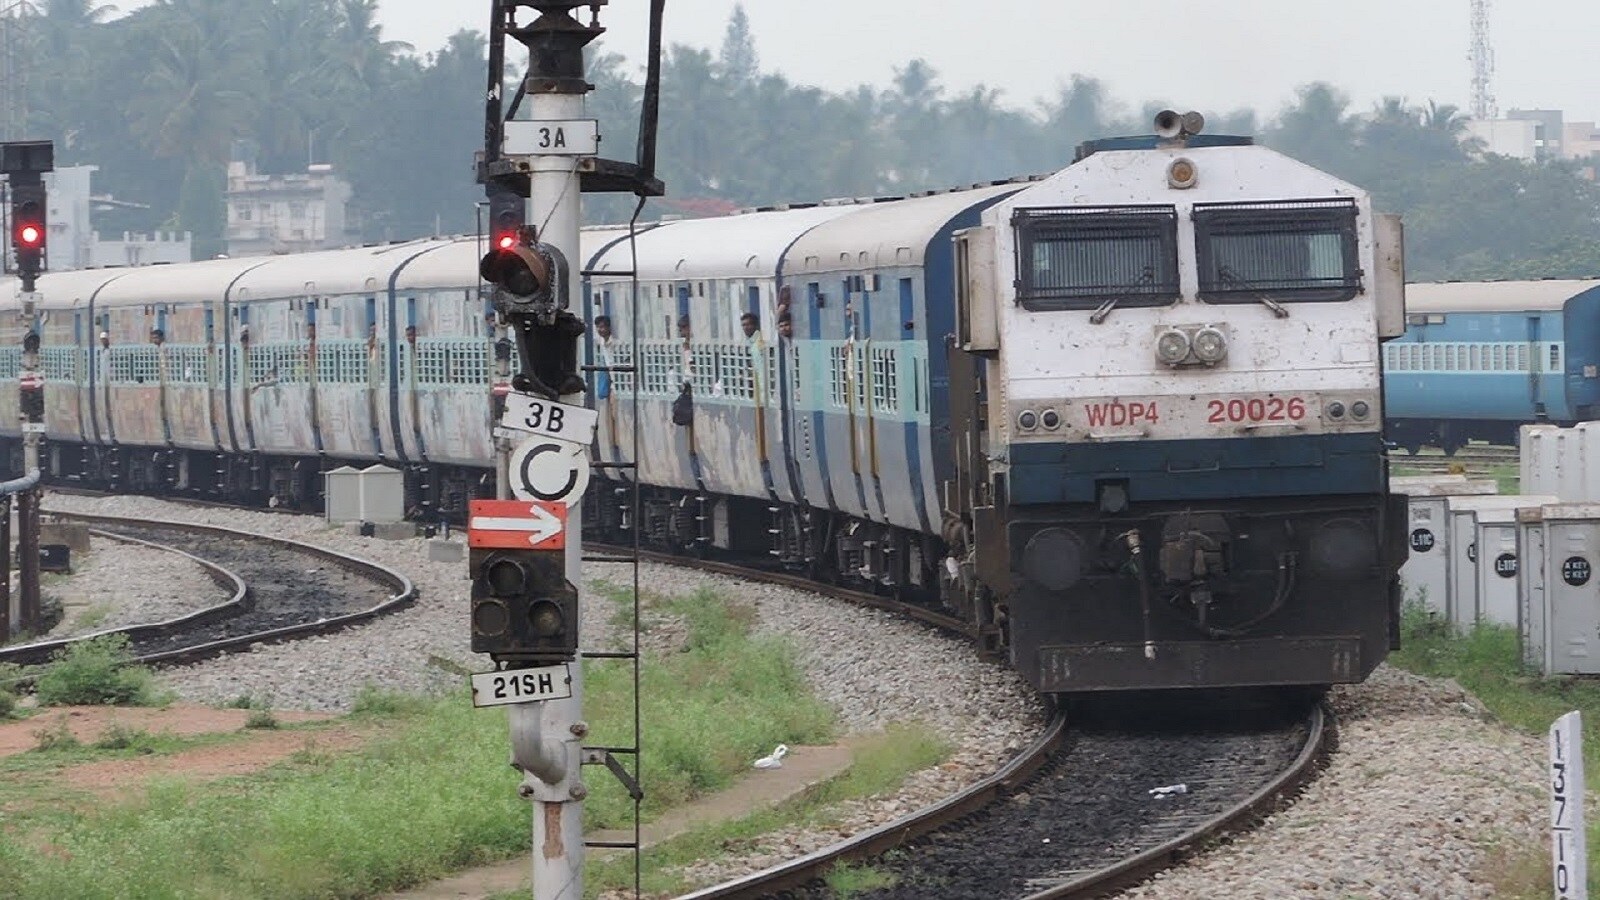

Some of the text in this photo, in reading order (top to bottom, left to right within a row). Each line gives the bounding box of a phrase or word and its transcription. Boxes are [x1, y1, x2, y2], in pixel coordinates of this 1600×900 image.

[538, 127, 566, 148] 3A
[524, 402, 565, 433] 3B
[1085, 397, 1305, 427] WDP4 20026
[520, 443, 578, 501] C
[493, 672, 554, 698] 21SH
